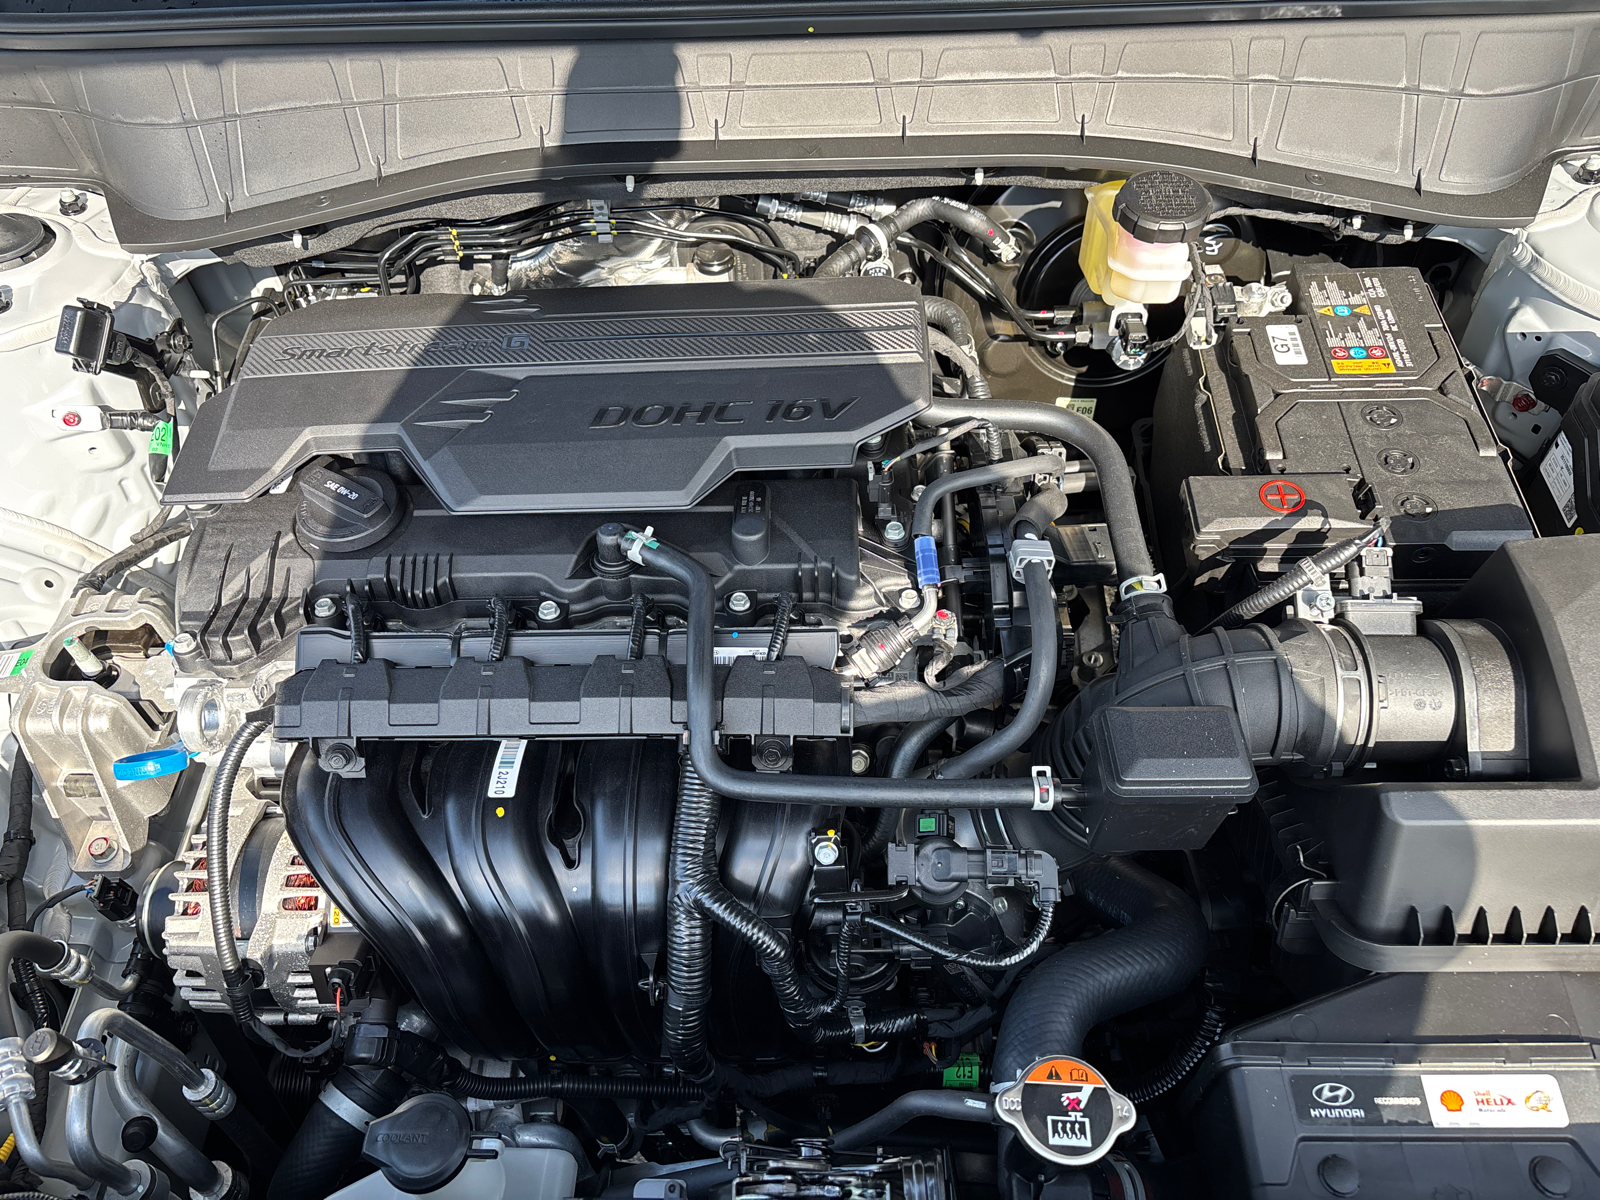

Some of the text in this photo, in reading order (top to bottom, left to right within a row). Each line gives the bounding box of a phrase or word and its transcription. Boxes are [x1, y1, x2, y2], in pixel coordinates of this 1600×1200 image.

[275, 338, 493, 361] Smartstream
[1271, 335, 1291, 354] G7
[589, 396, 861, 429] DOHC 16V
[323, 481, 340, 491] SAE
[493, 770, 510, 796] 2J210
[1475, 1096, 1517, 1106] HELIX
[1310, 1108, 1365, 1119] HYUNDAI
[376, 1132, 429, 1145] COOLANT
